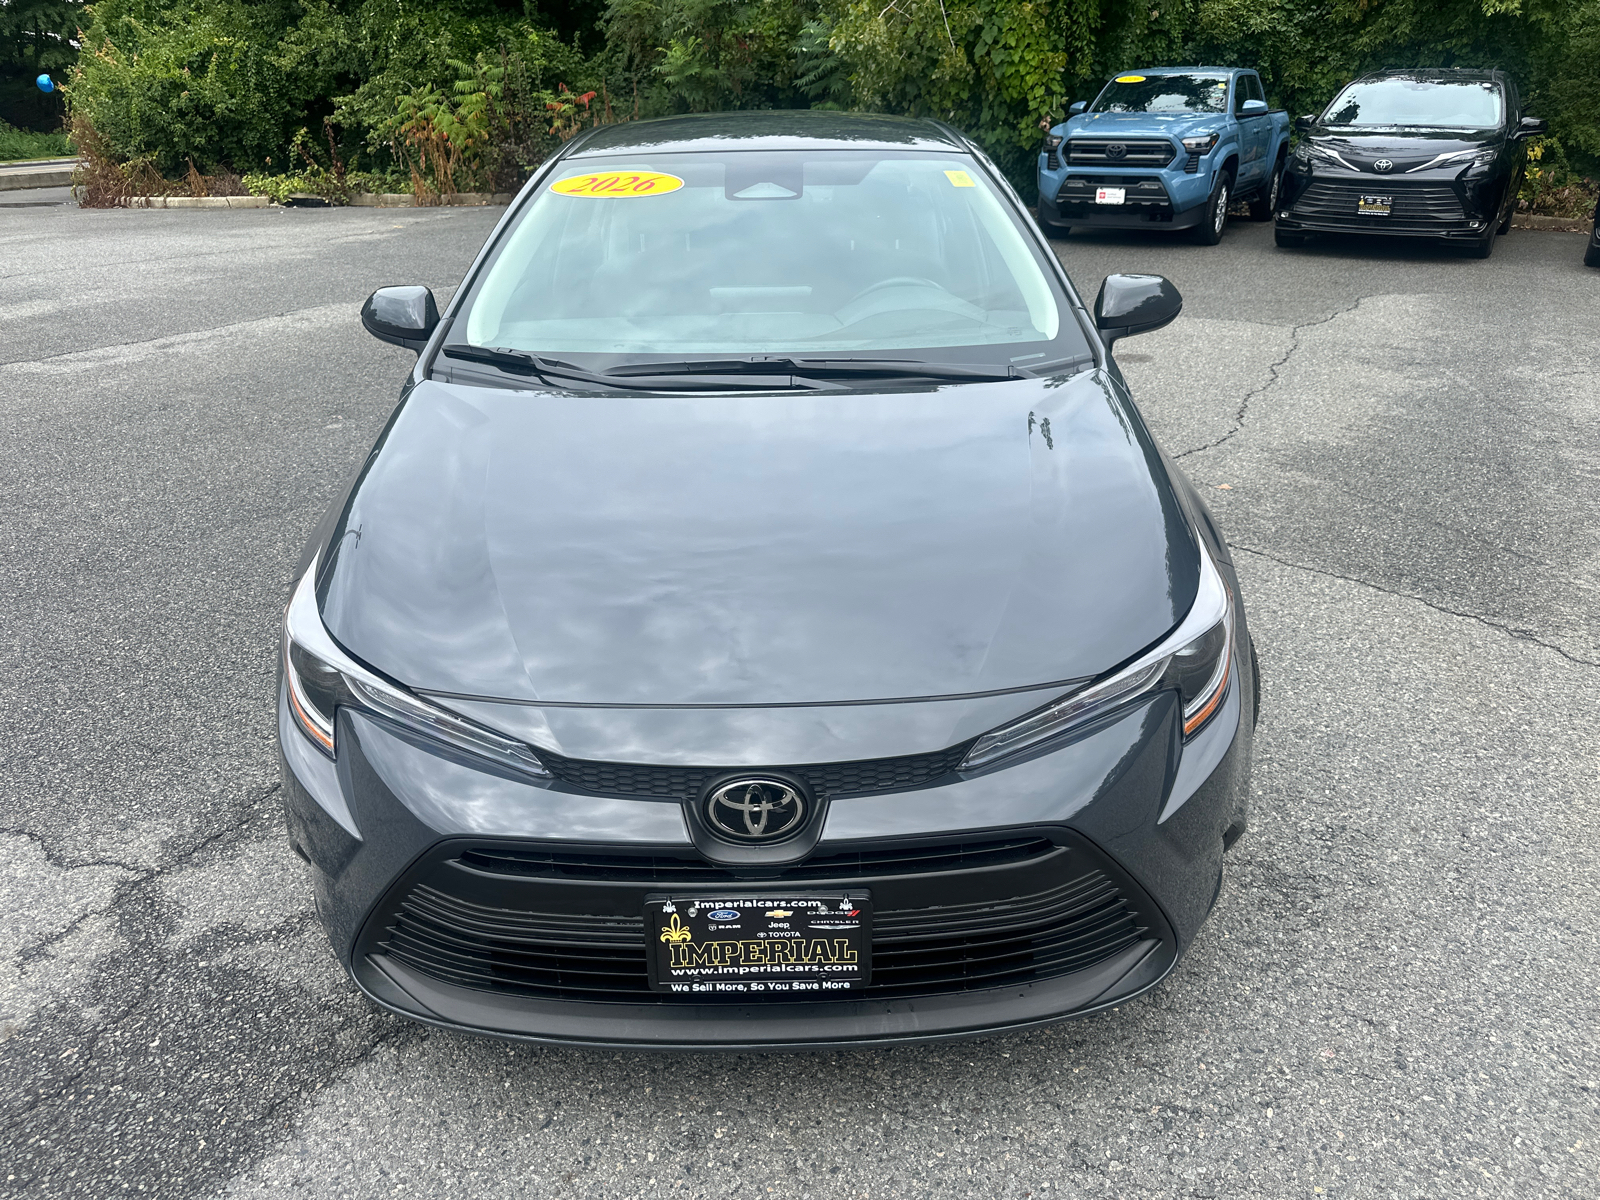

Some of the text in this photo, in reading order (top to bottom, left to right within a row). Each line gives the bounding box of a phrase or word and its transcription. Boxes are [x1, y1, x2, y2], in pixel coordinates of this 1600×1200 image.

[567, 176, 665, 193] 2026
[694, 900, 821, 909] Imperialcars.com
[669, 939, 857, 967] IMPERIAL
[671, 964, 858, 976] www.imperialcars.com
[671, 984, 690, 992] We
[692, 984, 712, 992] Sell
[716, 983, 747, 992] More,
[750, 983, 765, 991] So
[792, 982, 819, 990] Save
[822, 981, 851, 989] More
